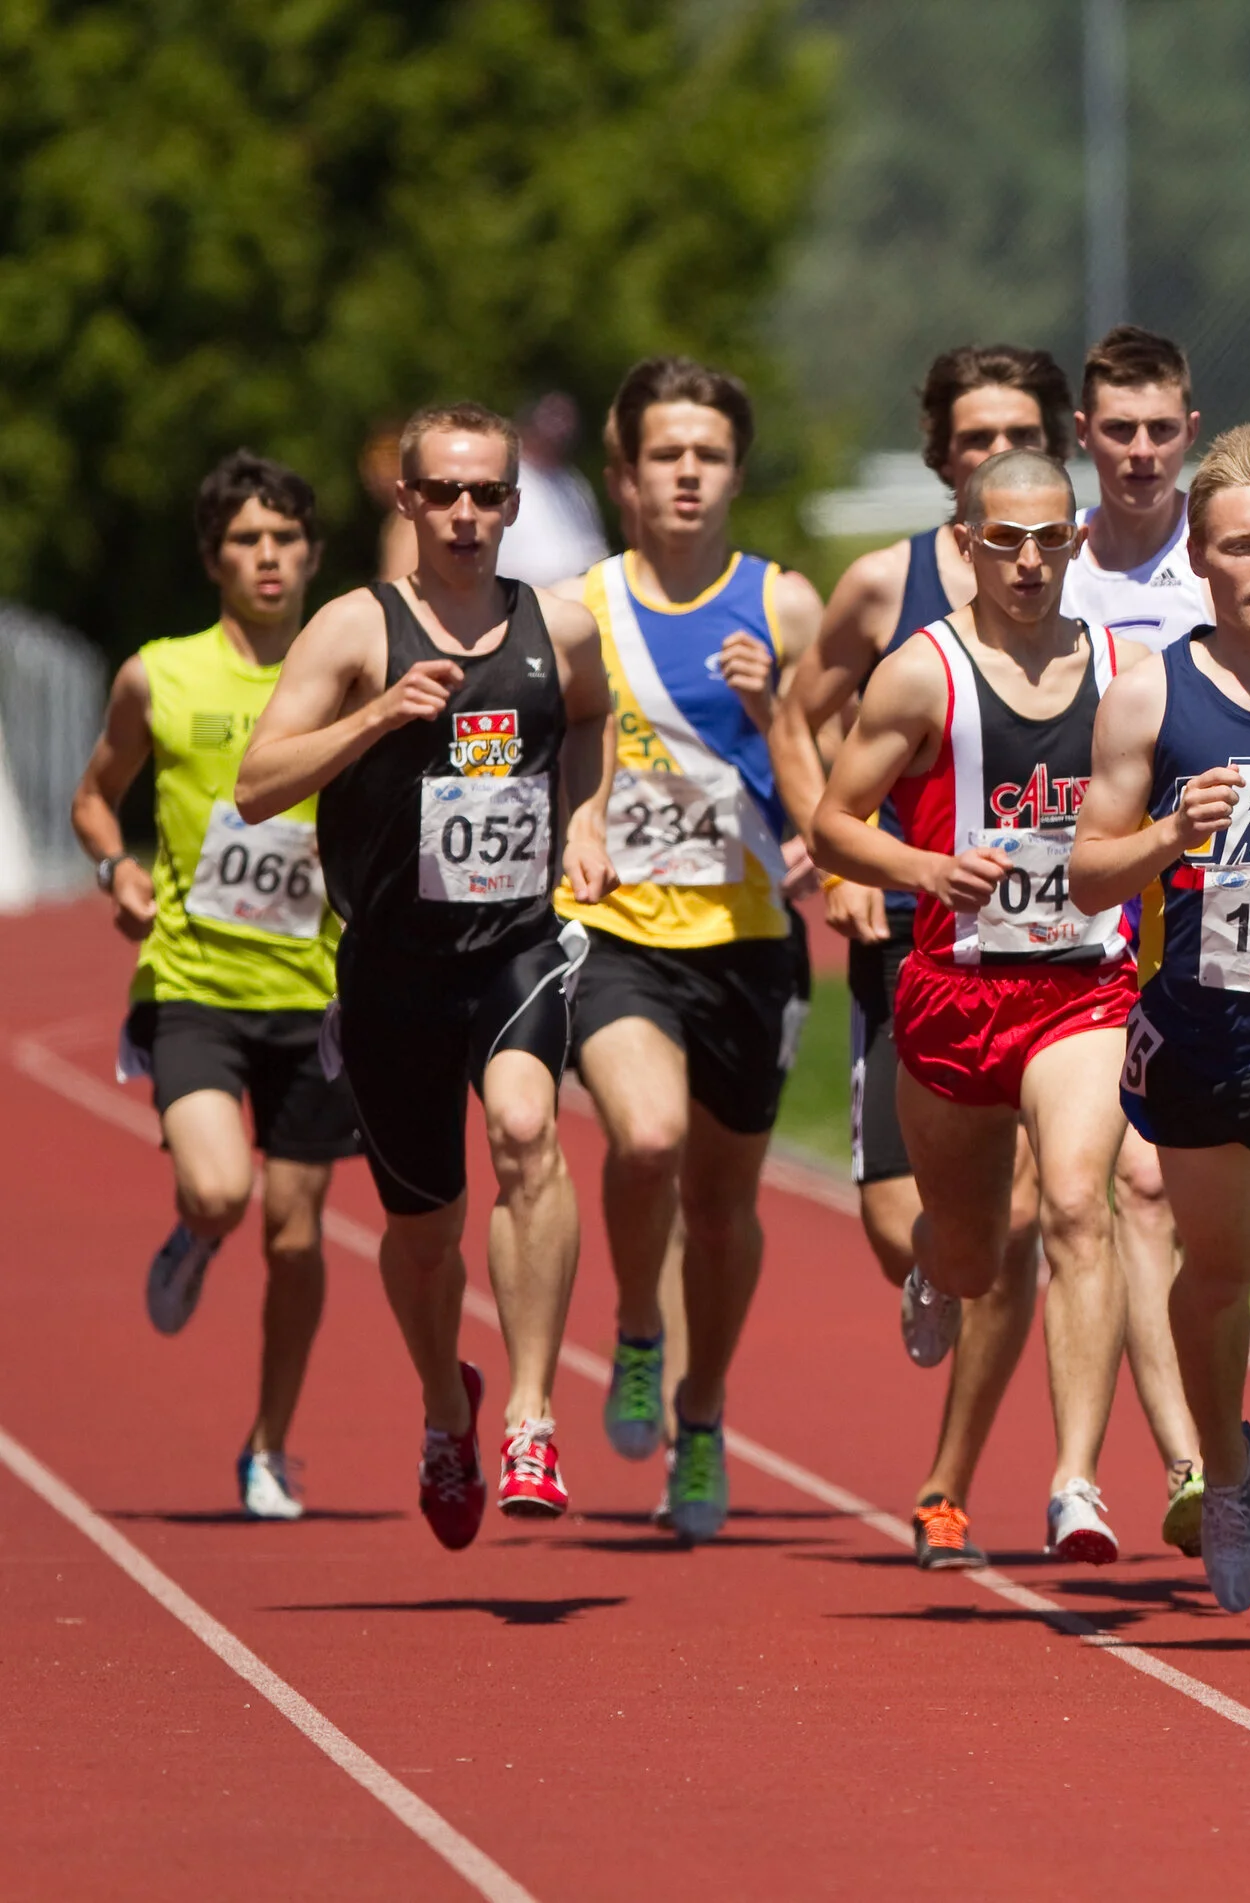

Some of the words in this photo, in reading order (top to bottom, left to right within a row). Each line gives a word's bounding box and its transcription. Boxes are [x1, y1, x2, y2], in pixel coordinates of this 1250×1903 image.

[448, 737, 524, 769] UCAC
[441, 814, 538, 865] 052
[625, 802, 717, 846] 234
[219, 844, 314, 900] 066
[488, 873, 515, 890] NTL
[999, 863, 1070, 915] 04
[1047, 923, 1079, 943] NTL
